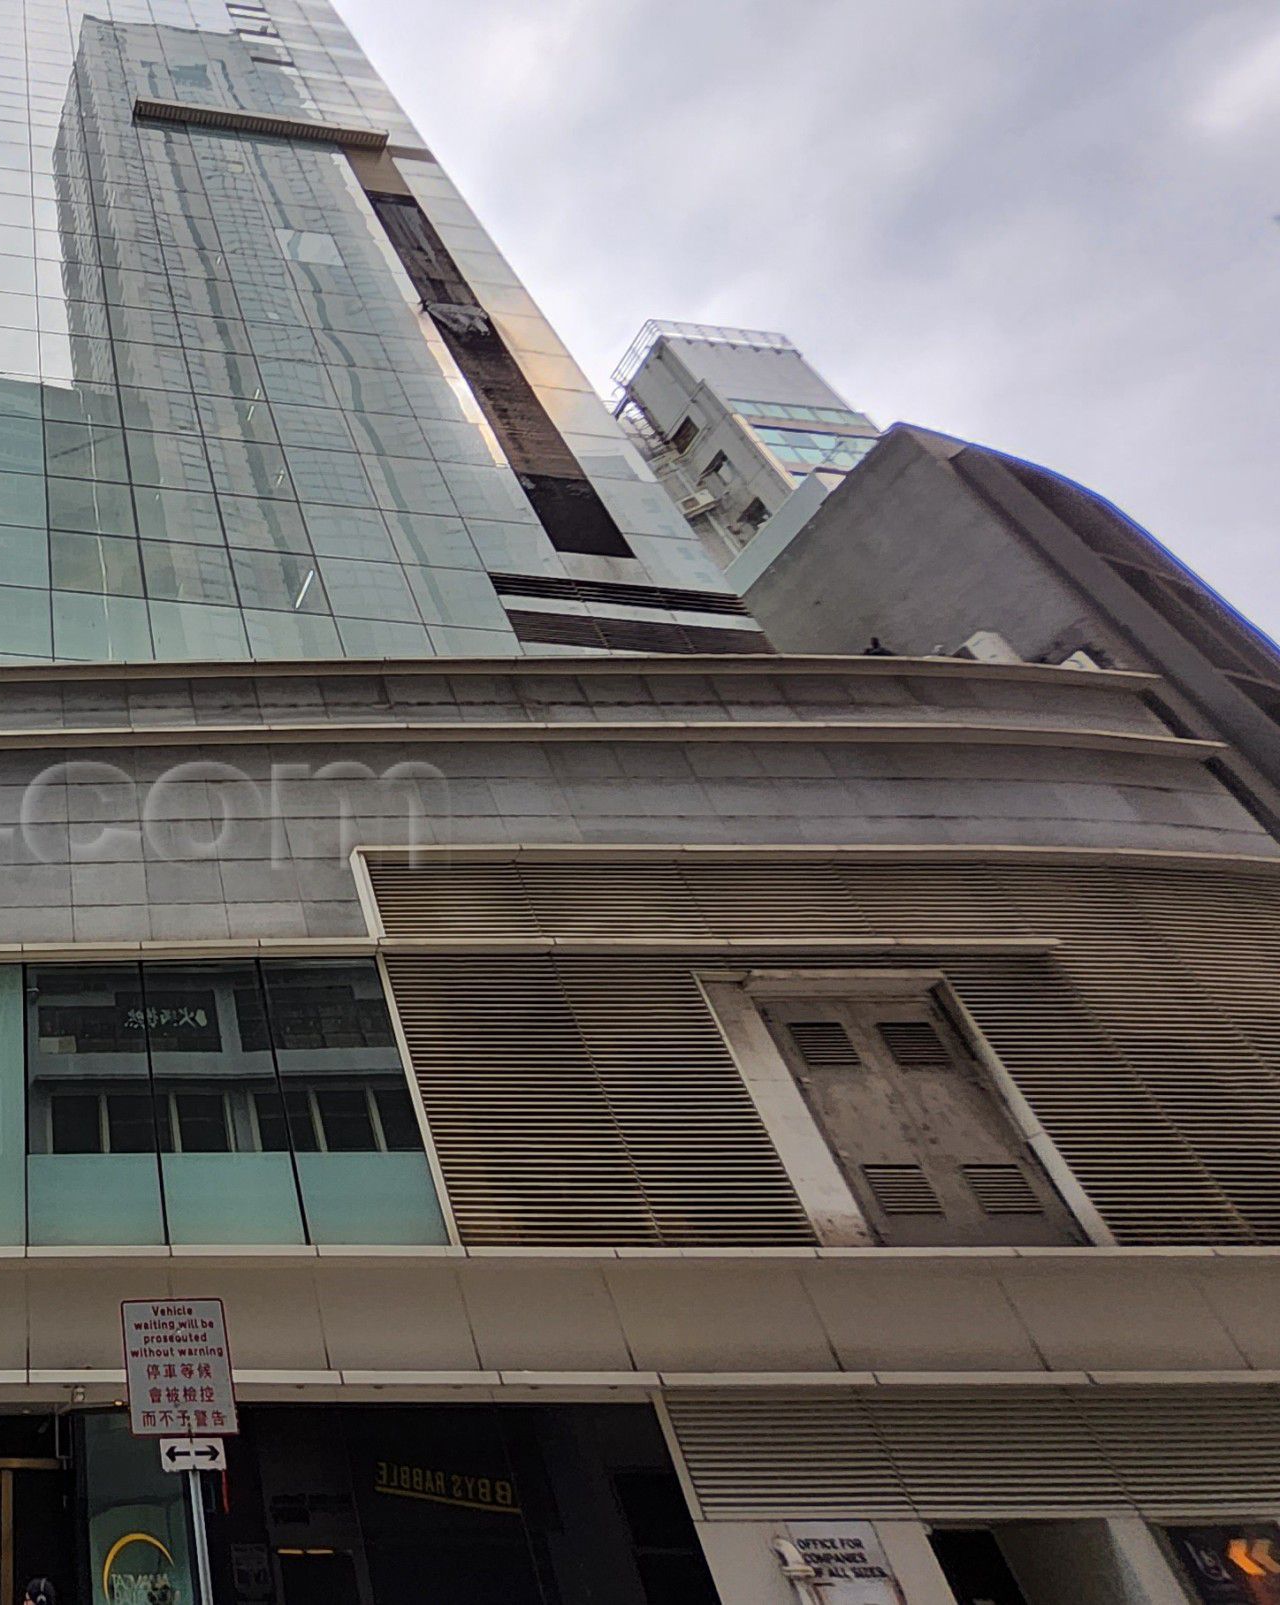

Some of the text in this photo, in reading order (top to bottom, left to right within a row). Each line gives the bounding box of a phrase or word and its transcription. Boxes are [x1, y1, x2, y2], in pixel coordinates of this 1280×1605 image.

[152, 1305, 193, 1316] Vehicle
[134, 1318, 214, 1331] waiting will be
[143, 1333, 207, 1345] prosecuted
[130, 1346, 224, 1358] without warning
[147, 1363, 212, 1380] 停車等候
[148, 1385, 214, 1404] 會被檢控
[142, 1410, 226, 1427] 而不予警告
[797, 1538, 864, 1550] OFFICE FOR
[802, 1552, 868, 1563] COMPANIES
[828, 1567, 851, 1578] ALL
[852, 1567, 888, 1578] SIZES
